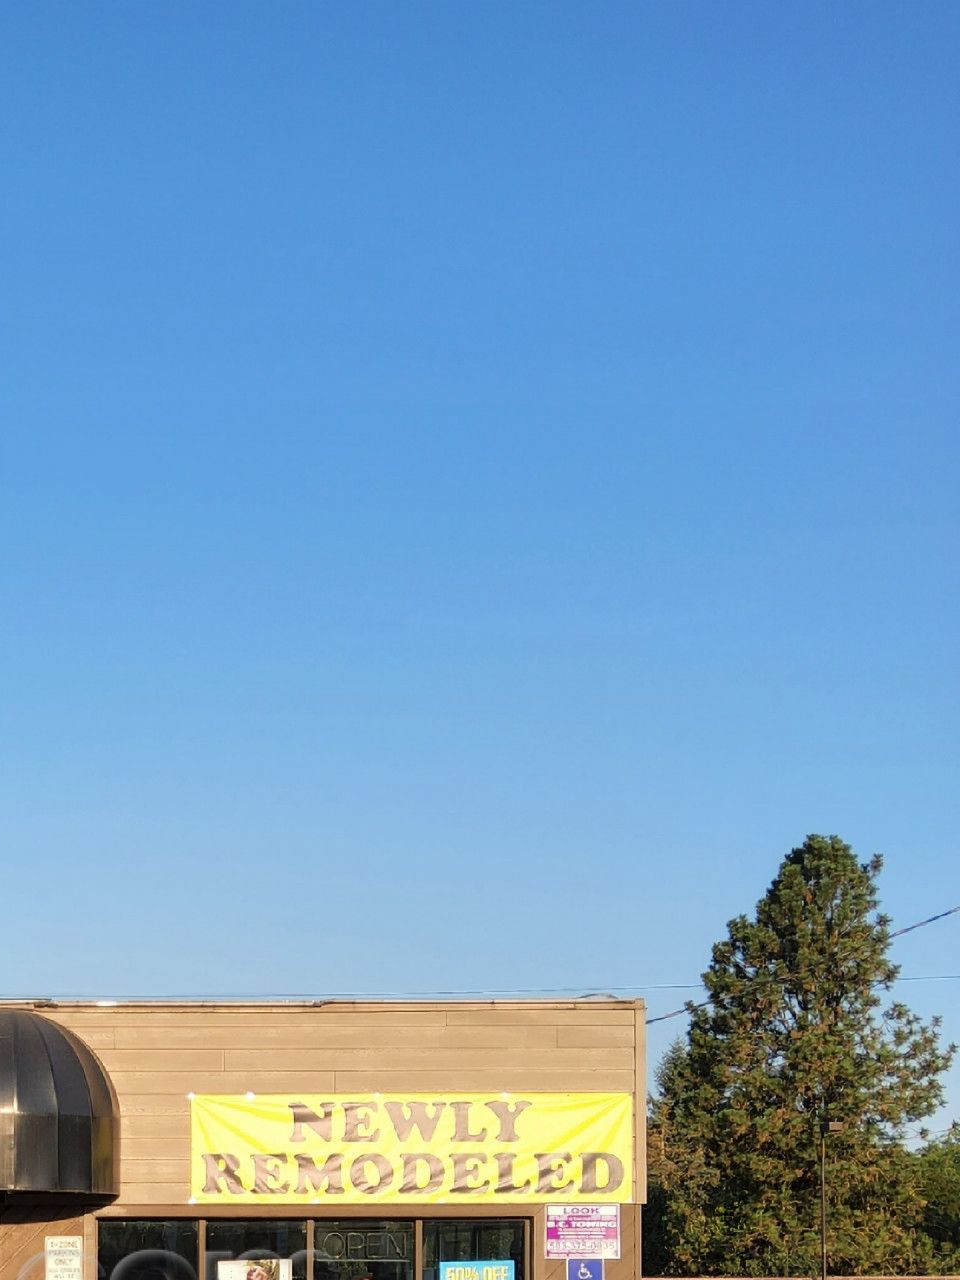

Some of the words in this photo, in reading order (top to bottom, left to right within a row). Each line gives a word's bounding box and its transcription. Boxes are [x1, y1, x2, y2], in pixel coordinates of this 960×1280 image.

[288, 1101, 532, 1143] NEWLY
[201, 1152, 625, 1195] REMODELED
[323, 1232, 407, 1258] OPEN
